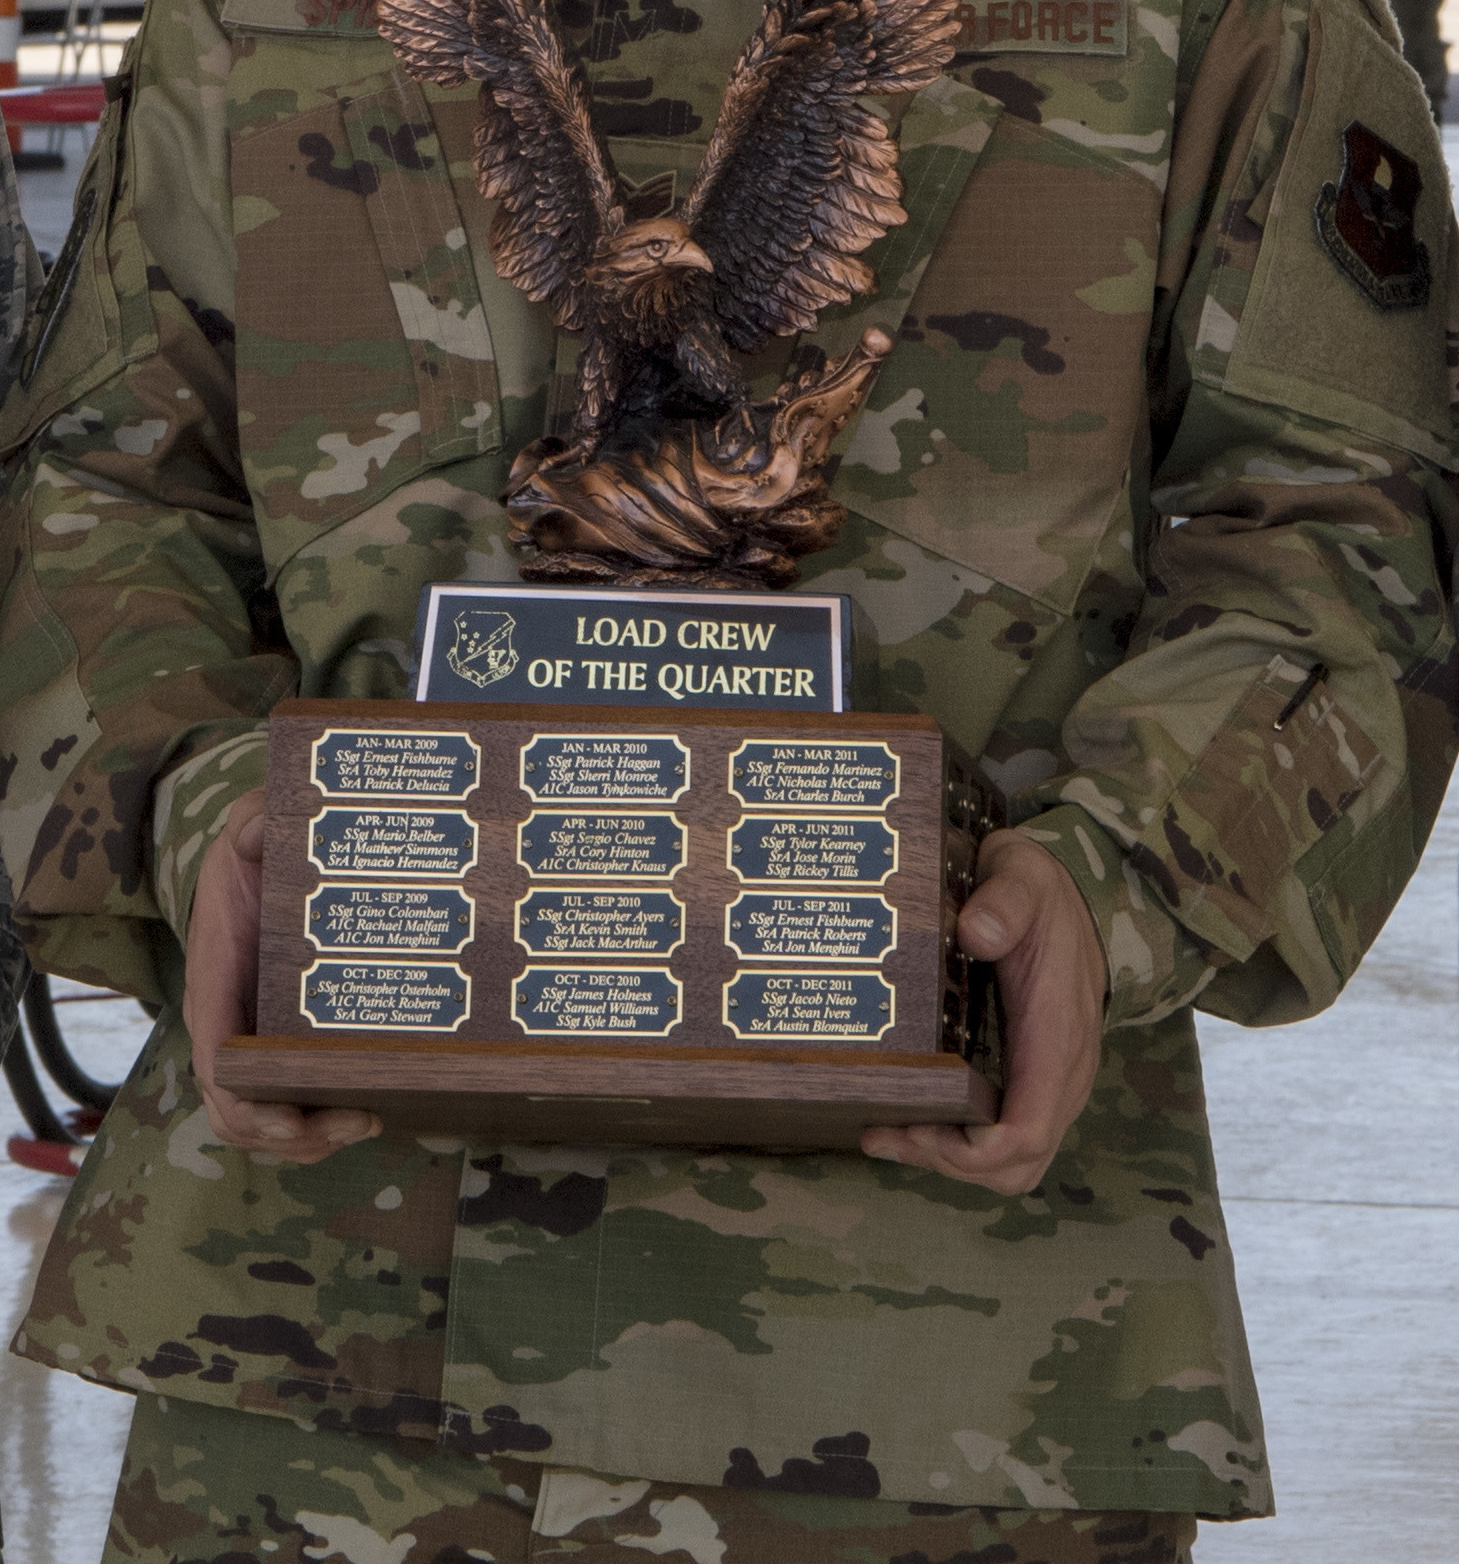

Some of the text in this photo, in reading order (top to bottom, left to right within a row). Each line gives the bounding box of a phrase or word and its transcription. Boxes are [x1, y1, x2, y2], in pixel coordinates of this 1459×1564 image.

[987, 0, 1115, 44] FORCE
[575, 616, 776, 651] LOAD CREW
[527, 659, 571, 689] OF
[581, 660, 647, 691] THE
[656, 663, 817, 700] QUARTER
[385, 738, 412, 749] MAR
[415, 740, 438, 749] 2009
[562, 743, 647, 753] JAN MAR 2010
[335, 750, 457, 764] SSgt Ernest Fishburne
[772, 749, 857, 760] JAN MAR 2011
[547, 756, 660, 771] SSgt Patrick Haggan
[747, 761, 882, 777] SSgt Fernando Martinez
[338, 764, 453, 778] SrA Toby Hernandez
[549, 769, 658, 785] SSgt Sherri Monroe
[340, 777, 450, 791] SrA Patrick Delucia
[566, 783, 598, 794] Jason
[777, 776, 826, 788] Nicholas
[830, 778, 882, 790] McCants
[764, 789, 864, 802] SrA Charles Burch
[385, 816, 409, 826] JUN
[411, 817, 434, 826] 2009
[562, 819, 644, 829] APR JUN 2010
[344, 828, 368, 843] SSgt
[409, 830, 445, 842] Belber
[772, 824, 854, 835] APR JUN 2011
[549, 831, 574, 846] SSgt
[615, 833, 656, 844] Chavez
[760, 836, 866, 853] SSgt Tylor Kearney
[329, 841, 458, 856] SrA Matthew Simmons
[555, 846, 650, 860] SrA Cory Hinton
[328, 855, 458, 869] SrA Ignacio Hernandez
[769, 850, 856, 863] SrA Jose Morin
[566, 859, 629, 874] Christopher
[631, 860, 666, 872] Knaus
[766, 864, 859, 879] SSgt Rickey Tillis
[350, 892, 428, 903] JUL SEP 2009
[562, 896, 641, 907] JUL SEP 2010
[328, 904, 354, 919] SSgt
[357, 906, 385, 917] Gino
[772, 900, 850, 912] JUL SEP 2011
[537, 909, 664, 925] SSgt Christopher Ayers
[749, 912, 874, 928] SSgt Ernest Fishburne
[356, 920, 401, 931] Rachael
[554, 923, 647, 936] SrA Kevin Smith
[363, 933, 384, 944] Jon
[386, 934, 440, 947] Menghini
[755, 926, 867, 940] SrA Patrick Roberts
[544, 936, 658, 951] SSgt Jack MacArthur
[762, 940, 860, 956] SrA Jon Menghini
[343, 968, 428, 980] OCT DEC 2009
[555, 974, 640, 986] OCT DEC 2010
[317, 981, 339, 994] SSgt
[342, 982, 398, 996] Christopher
[767, 979, 852, 990] OCT DEC 2011
[542, 987, 652, 1002] SSgt James Holness
[762, 992, 857, 1006] SSgt Jacob Nieto
[356, 996, 396, 1008] Patrick
[399, 998, 441, 1009] Roberts
[563, 1002, 607, 1014] Samuel
[610, 1002, 659, 1014] Williams
[334, 1009, 432, 1024] SrA Gary Stewart
[768, 1006, 850, 1018] SrA Sean Ivers
[556, 1015, 636, 1030] SSgt Kyle Bush
[750, 1019, 868, 1034] SrA Austin Blomquist
